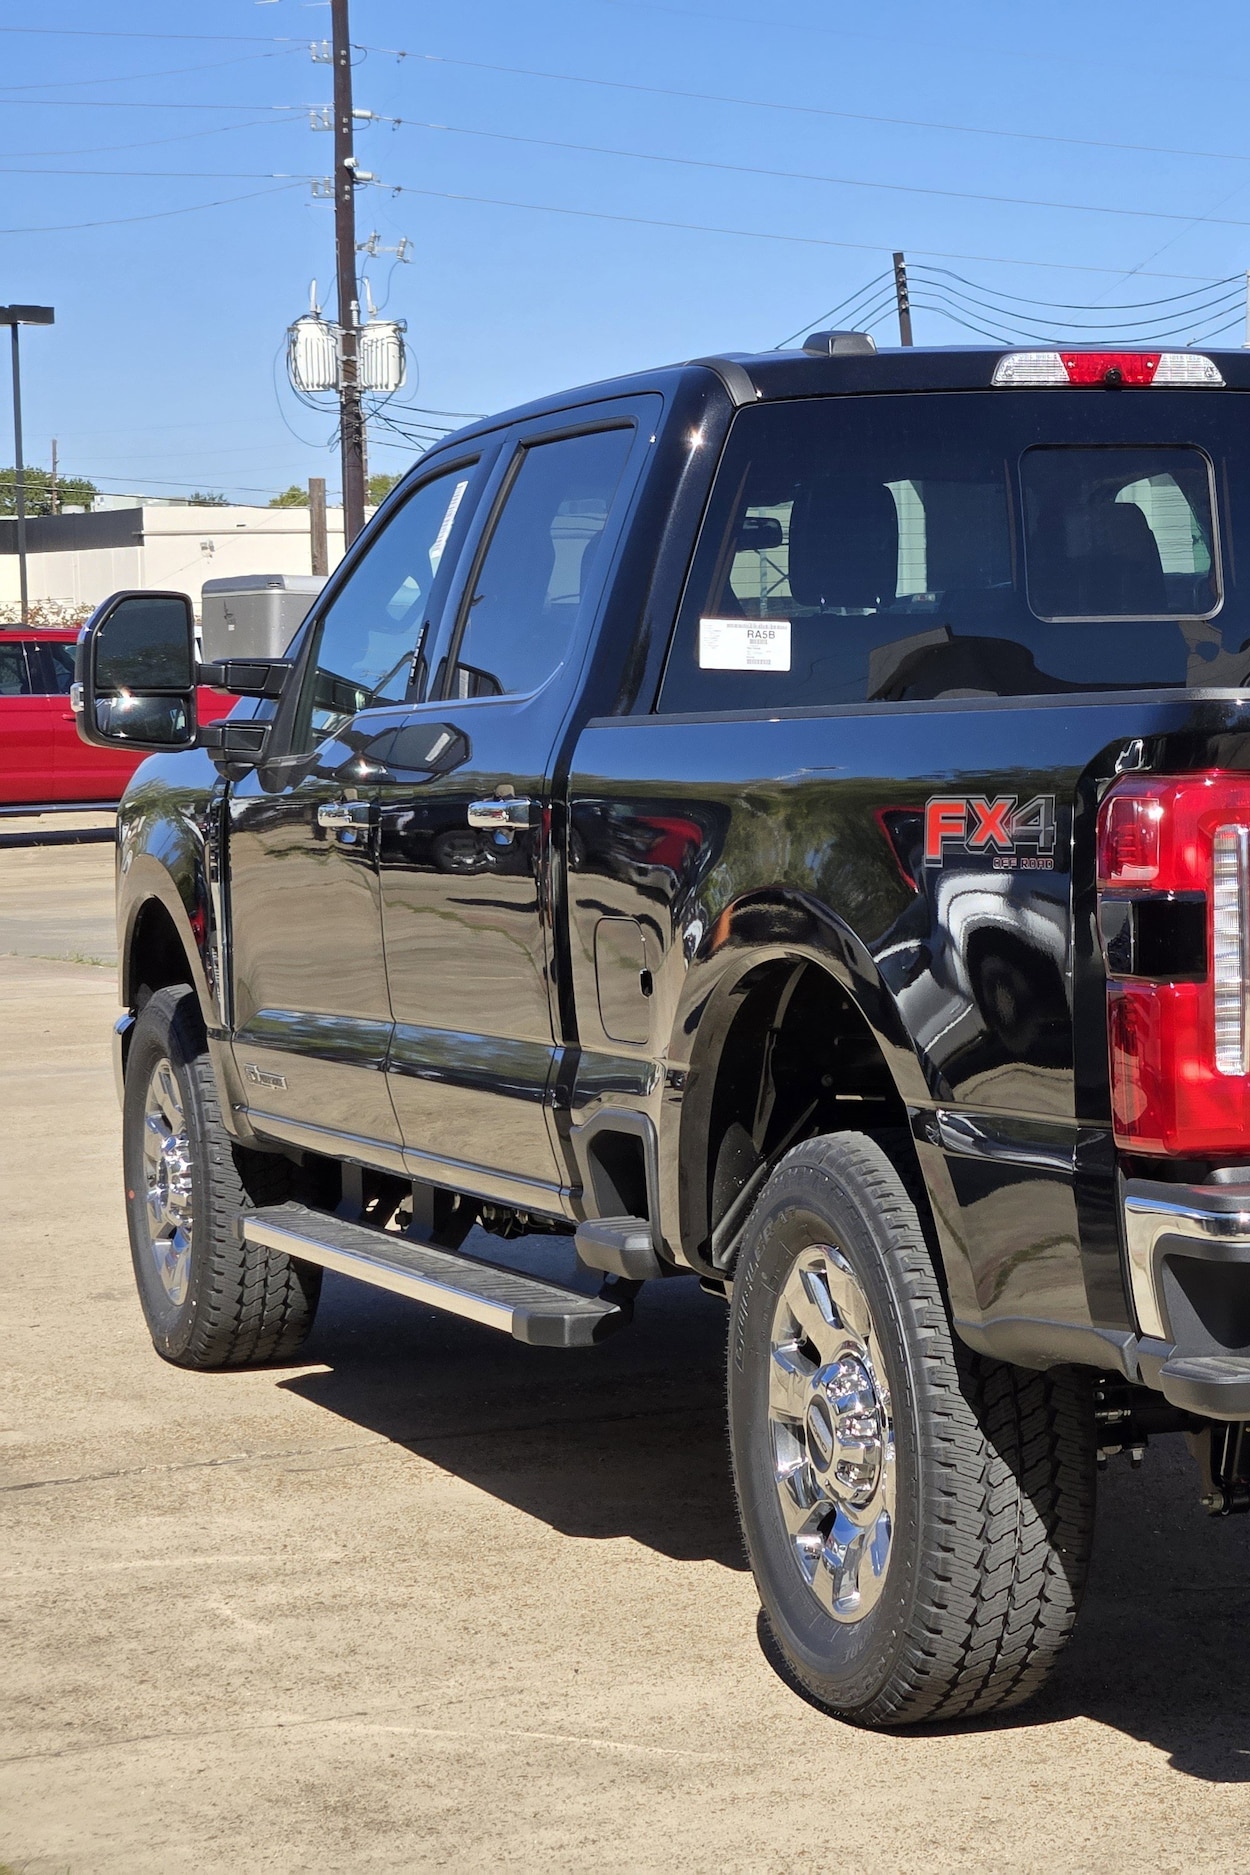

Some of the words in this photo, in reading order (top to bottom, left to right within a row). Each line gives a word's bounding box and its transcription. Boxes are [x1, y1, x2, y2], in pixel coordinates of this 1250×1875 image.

[747, 629, 776, 640] RA5B
[924, 794, 1057, 868] FX4
[993, 857, 1018, 870] OFF
[1020, 858, 1055, 870] ROAD
